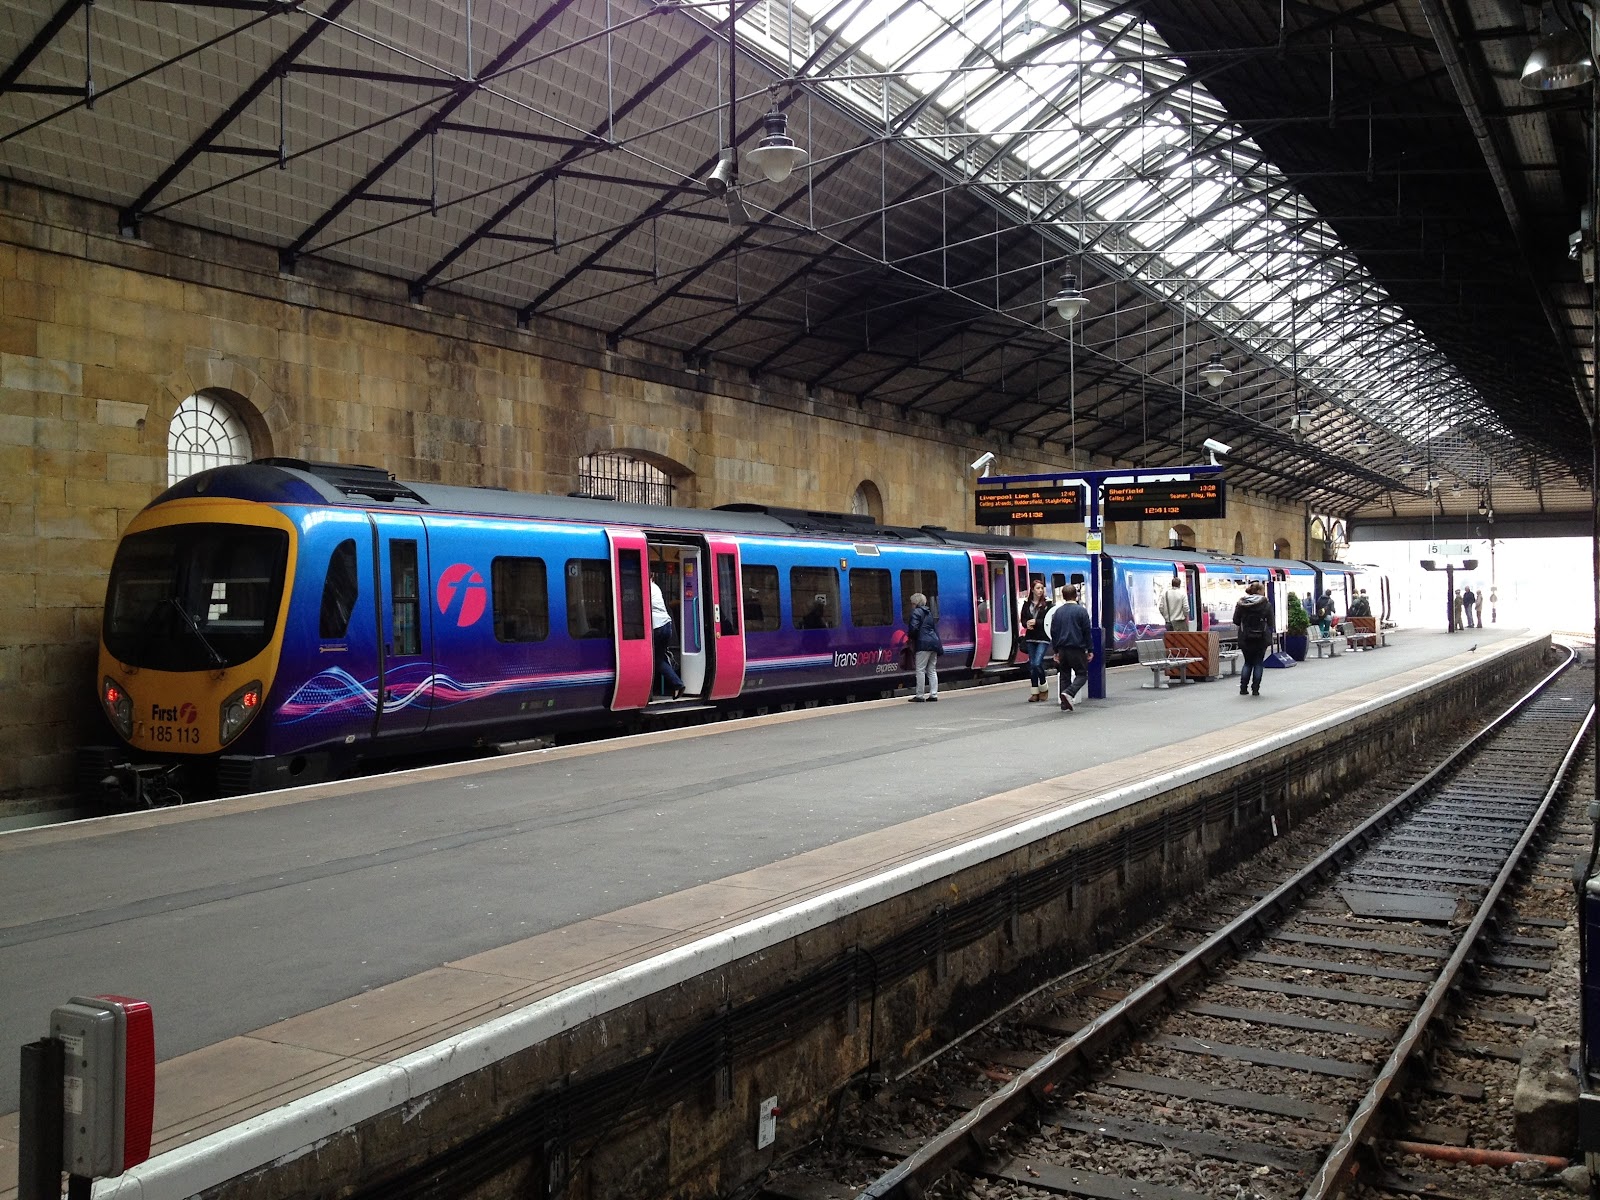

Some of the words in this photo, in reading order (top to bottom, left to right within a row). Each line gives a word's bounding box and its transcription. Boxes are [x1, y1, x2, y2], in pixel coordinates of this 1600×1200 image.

[570, 565, 577, 576] C
[834, 648, 892, 667] transpennine
[876, 663, 898, 673] express
[152, 704, 178, 722] First
[150, 726, 172, 742] 185
[176, 728, 199, 744] 113
